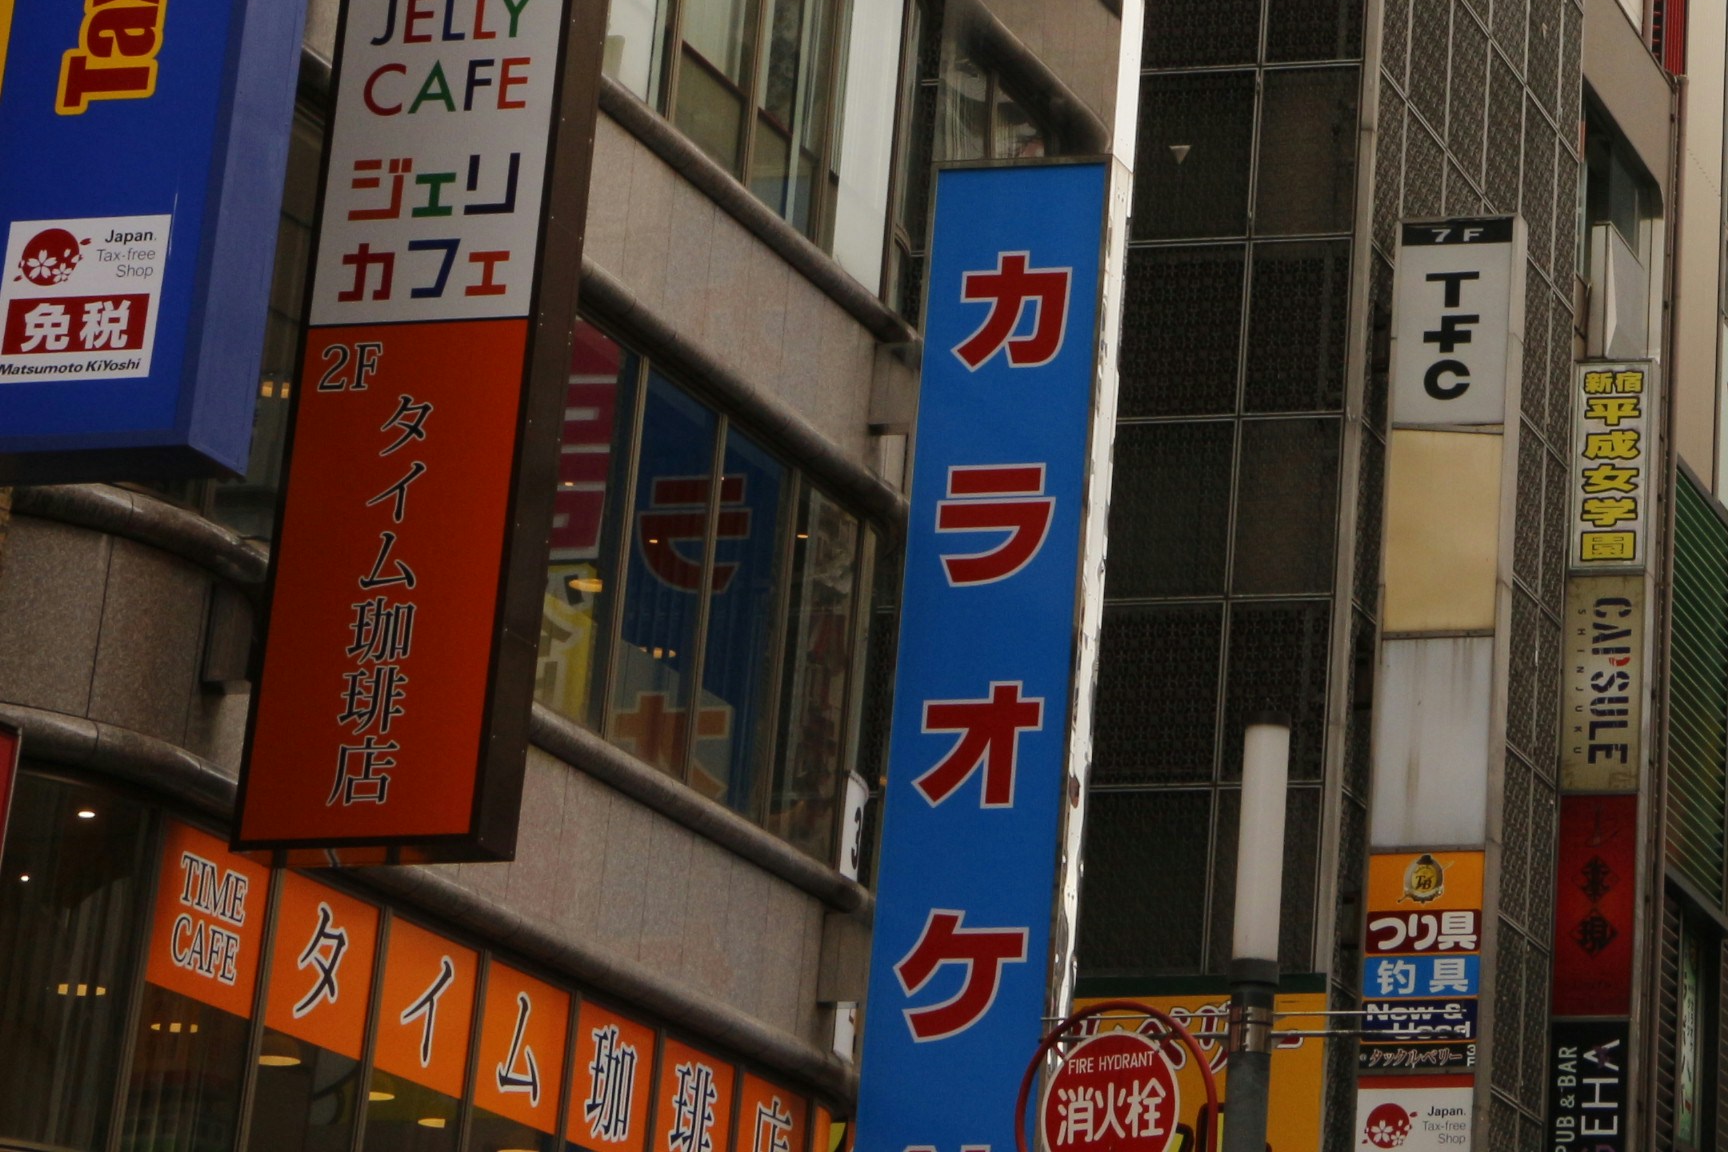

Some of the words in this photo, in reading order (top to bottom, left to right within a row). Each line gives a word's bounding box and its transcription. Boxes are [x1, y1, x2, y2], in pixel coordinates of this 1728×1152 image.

[363, 57, 532, 117] CAFE
[97, 248, 156, 262] Tax-free
[116, 264, 154, 279] Shop
[338, 238, 510, 303] カフェ
[20, 299, 132, 352] 免税
[1423, 271, 1480, 401] TFC
[0, 361, 83, 376] Matsumoto
[85, 357, 142, 371] KiYoshi
[317, 341, 383, 392] 2F
[1583, 371, 1644, 394] 新宿
[1580, 396, 1642, 562] 平成女学園
[325, 394, 433, 806] タイム珈琲店
[893, 250, 1073, 1152] カラオケ
[1573, 608, 1588, 754] SHINJUKU
[1588, 597, 1633, 764] CAPSULE
[180, 851, 248, 927] TIME
[171, 913, 240, 986] CAFE
[1369, 911, 1477, 950] つり具
[1068, 1056, 1094, 1075] FIRE
[1098, 1050, 1155, 1073] HYDRANT
[1368, 1047, 1464, 1069] タックルベリー
[1557, 1046, 1578, 1087] BAR
[1057, 1077, 1167, 1146] 消火栓
[1422, 1120, 1466, 1131] Tax-free
[1560, 1094, 1575, 1109] &
[1438, 1132, 1466, 1145] Shop
